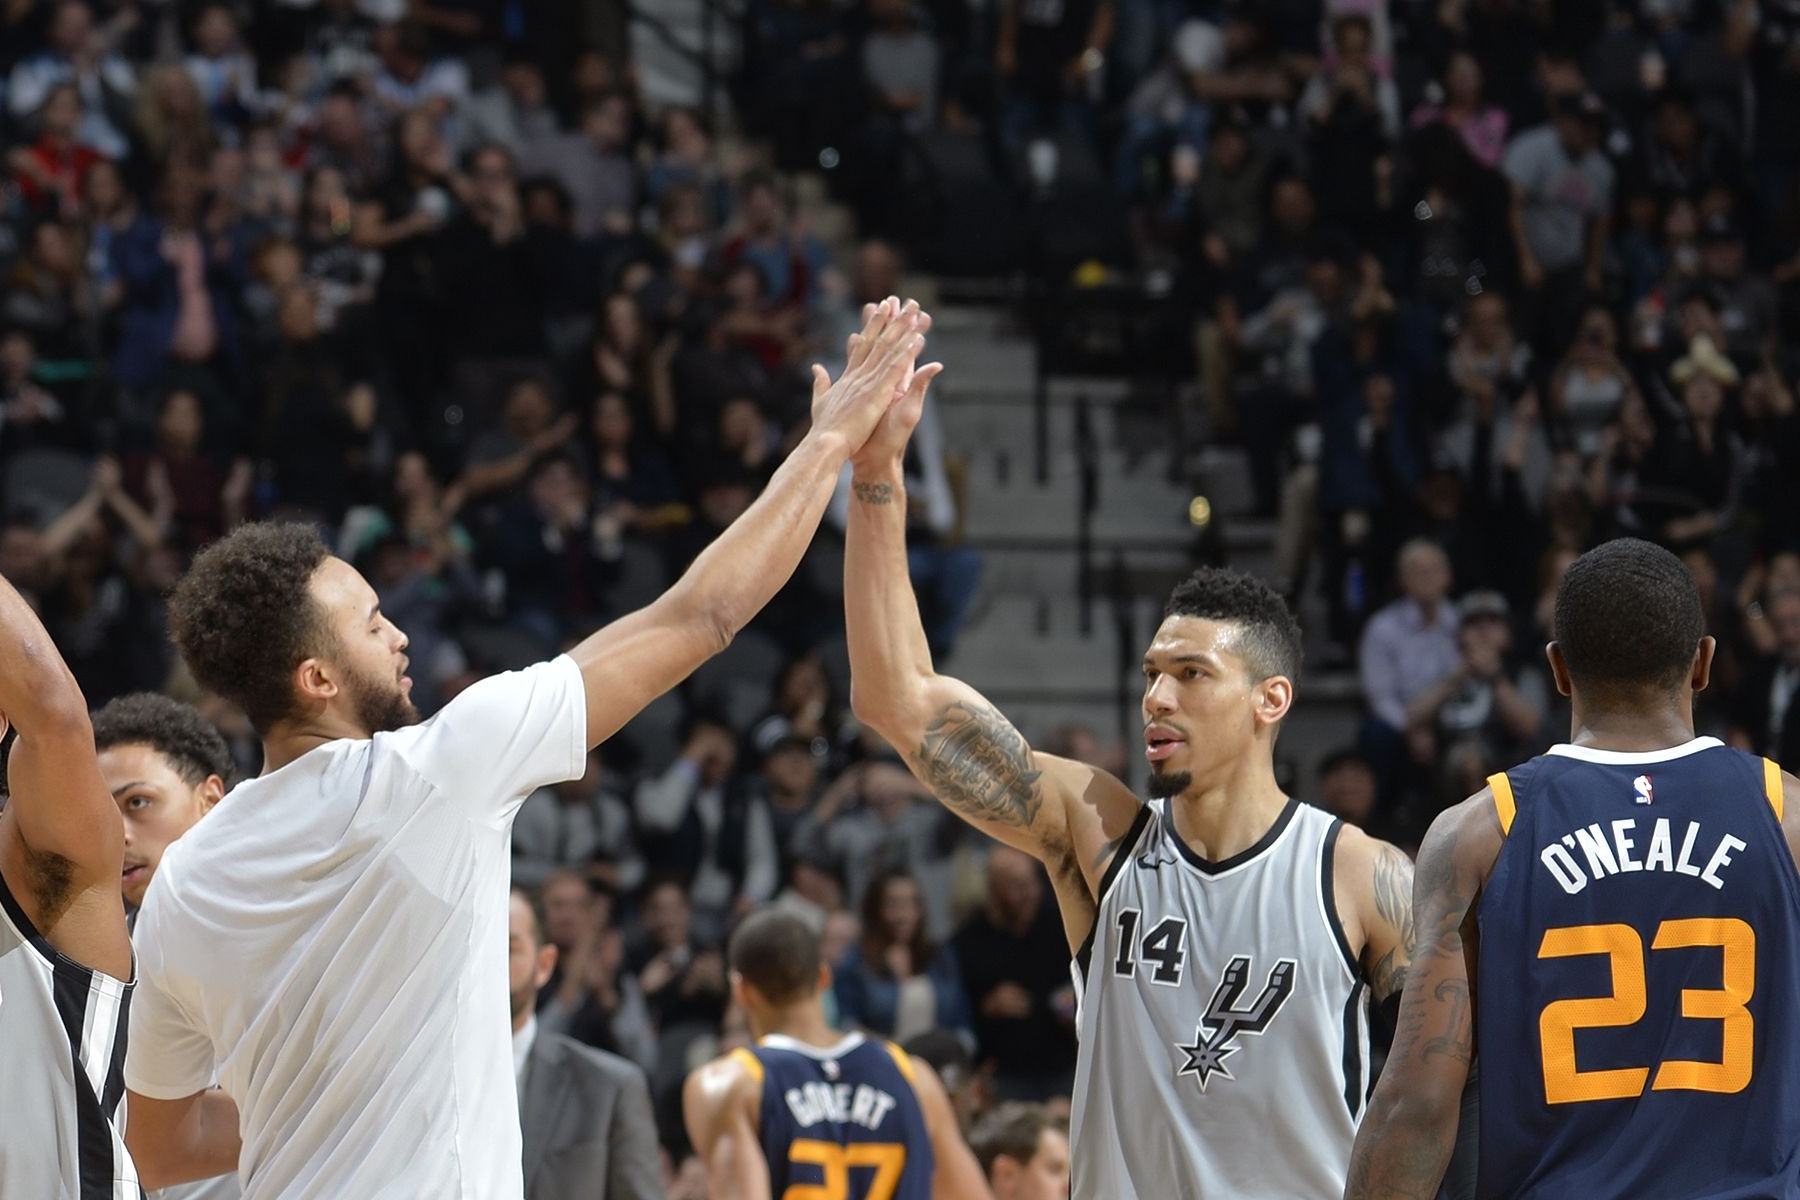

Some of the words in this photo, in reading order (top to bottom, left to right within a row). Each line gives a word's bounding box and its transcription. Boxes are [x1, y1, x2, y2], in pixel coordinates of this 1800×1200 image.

[1541, 817, 1748, 895] O'NEALE
[1114, 906, 1188, 988] 14
[1537, 917, 1757, 1105] 23
